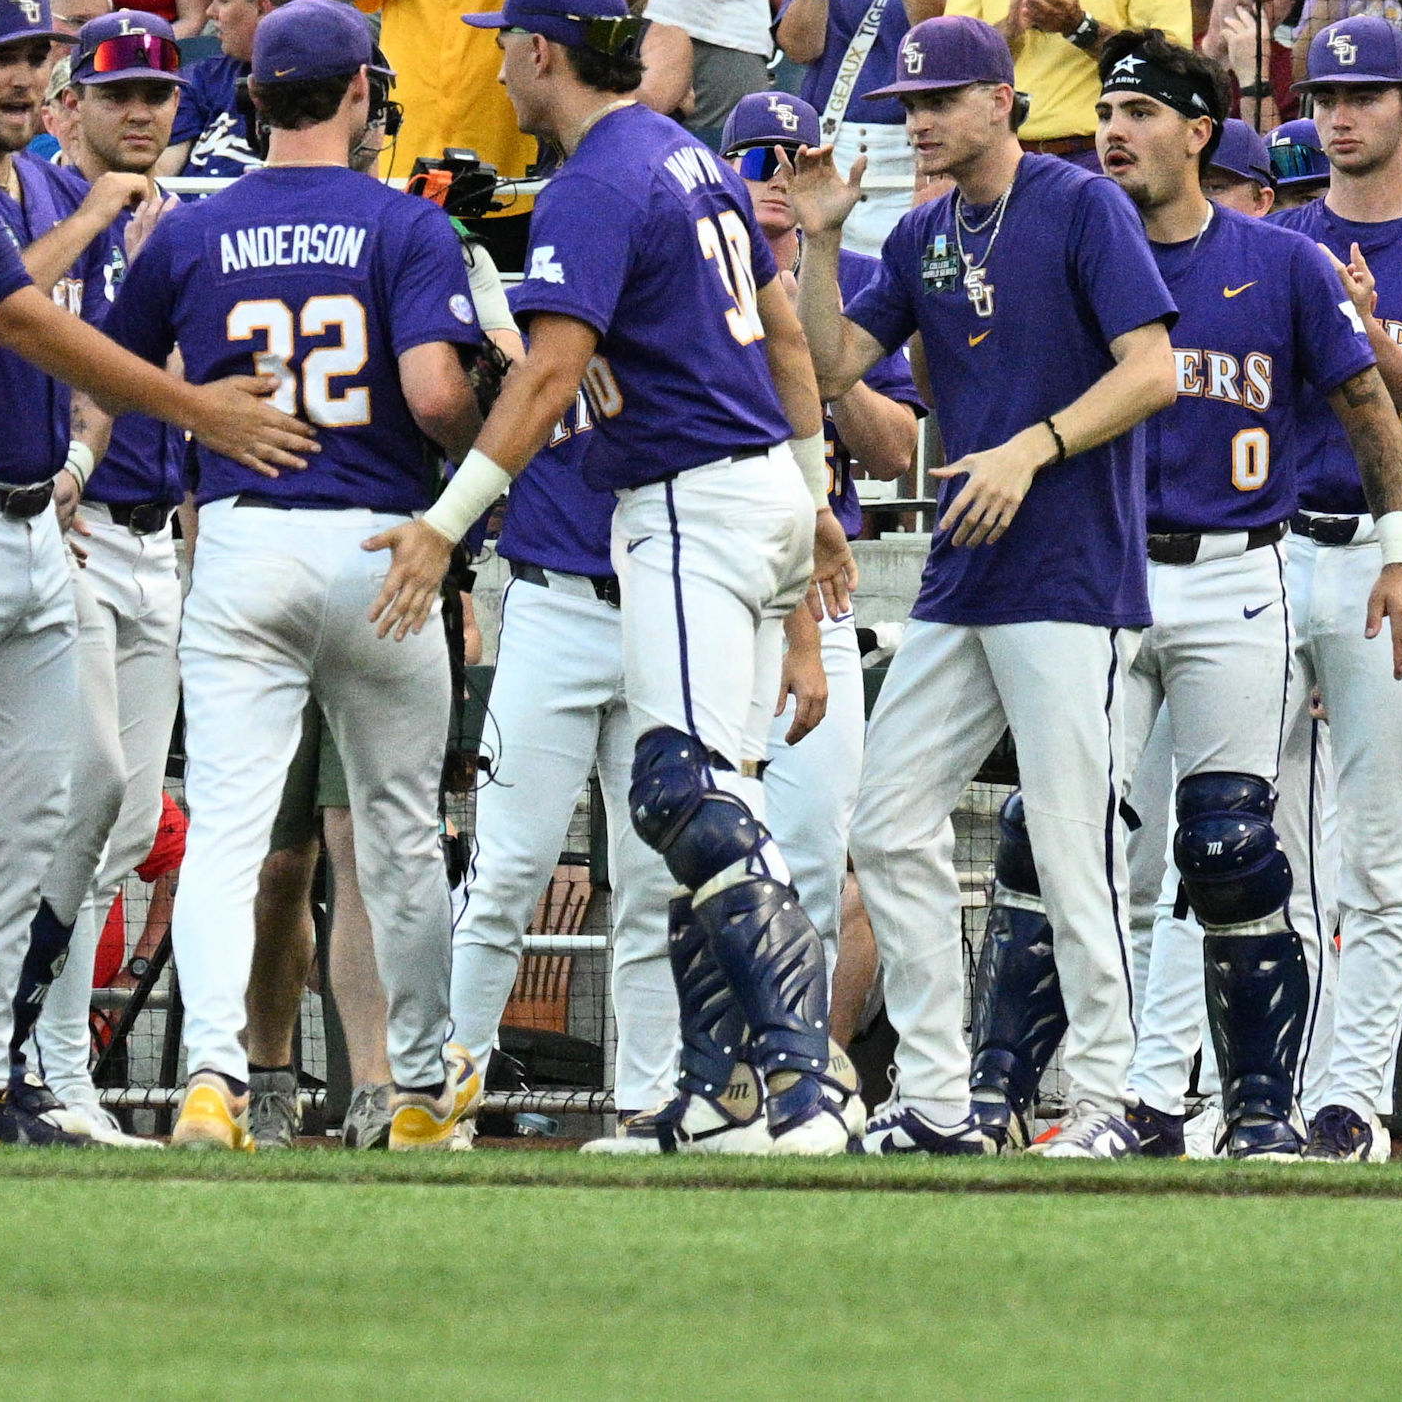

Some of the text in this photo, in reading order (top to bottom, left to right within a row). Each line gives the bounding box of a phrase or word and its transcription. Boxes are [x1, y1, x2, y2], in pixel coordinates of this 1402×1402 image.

[900, 34, 925, 74] LSU
[1326, 28, 1357, 66] LSU
[829, 46, 869, 114] GEAUX
[1115, 77, 1141, 86] ARMY
[768, 95, 800, 131] LSU
[219, 223, 366, 270] ANDERSON
[961, 251, 995, 317] LSU
[226, 293, 373, 430] 32
[1230, 425, 1271, 491] 0
